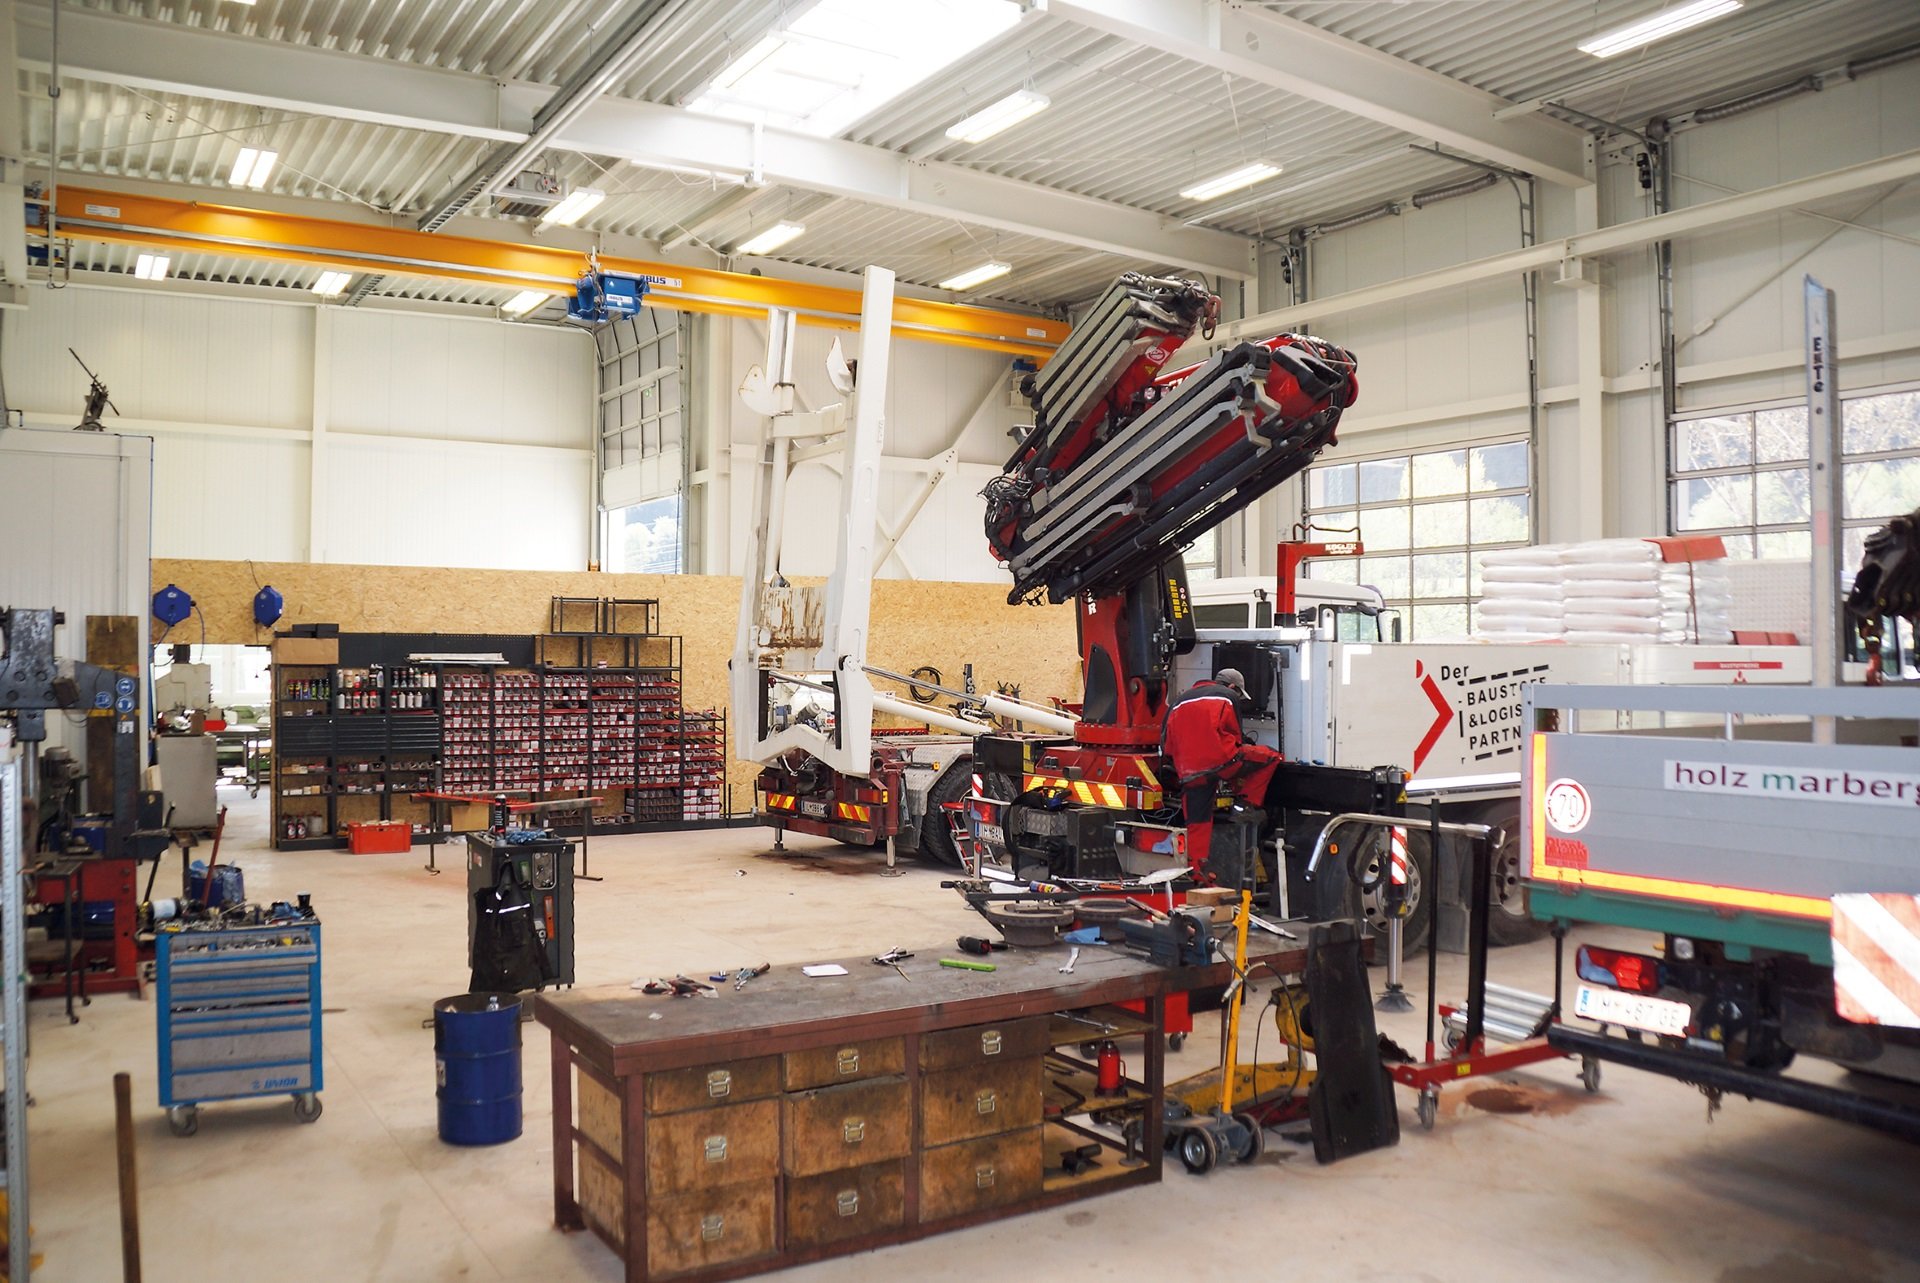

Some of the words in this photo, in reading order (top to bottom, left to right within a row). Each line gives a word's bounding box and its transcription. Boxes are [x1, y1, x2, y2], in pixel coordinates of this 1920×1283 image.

[1441, 665, 1469, 681] Der
[1467, 677, 1546, 706] BAUST
[1676, 762, 1748, 788] holz
[1762, 772, 1920, 806] marber
